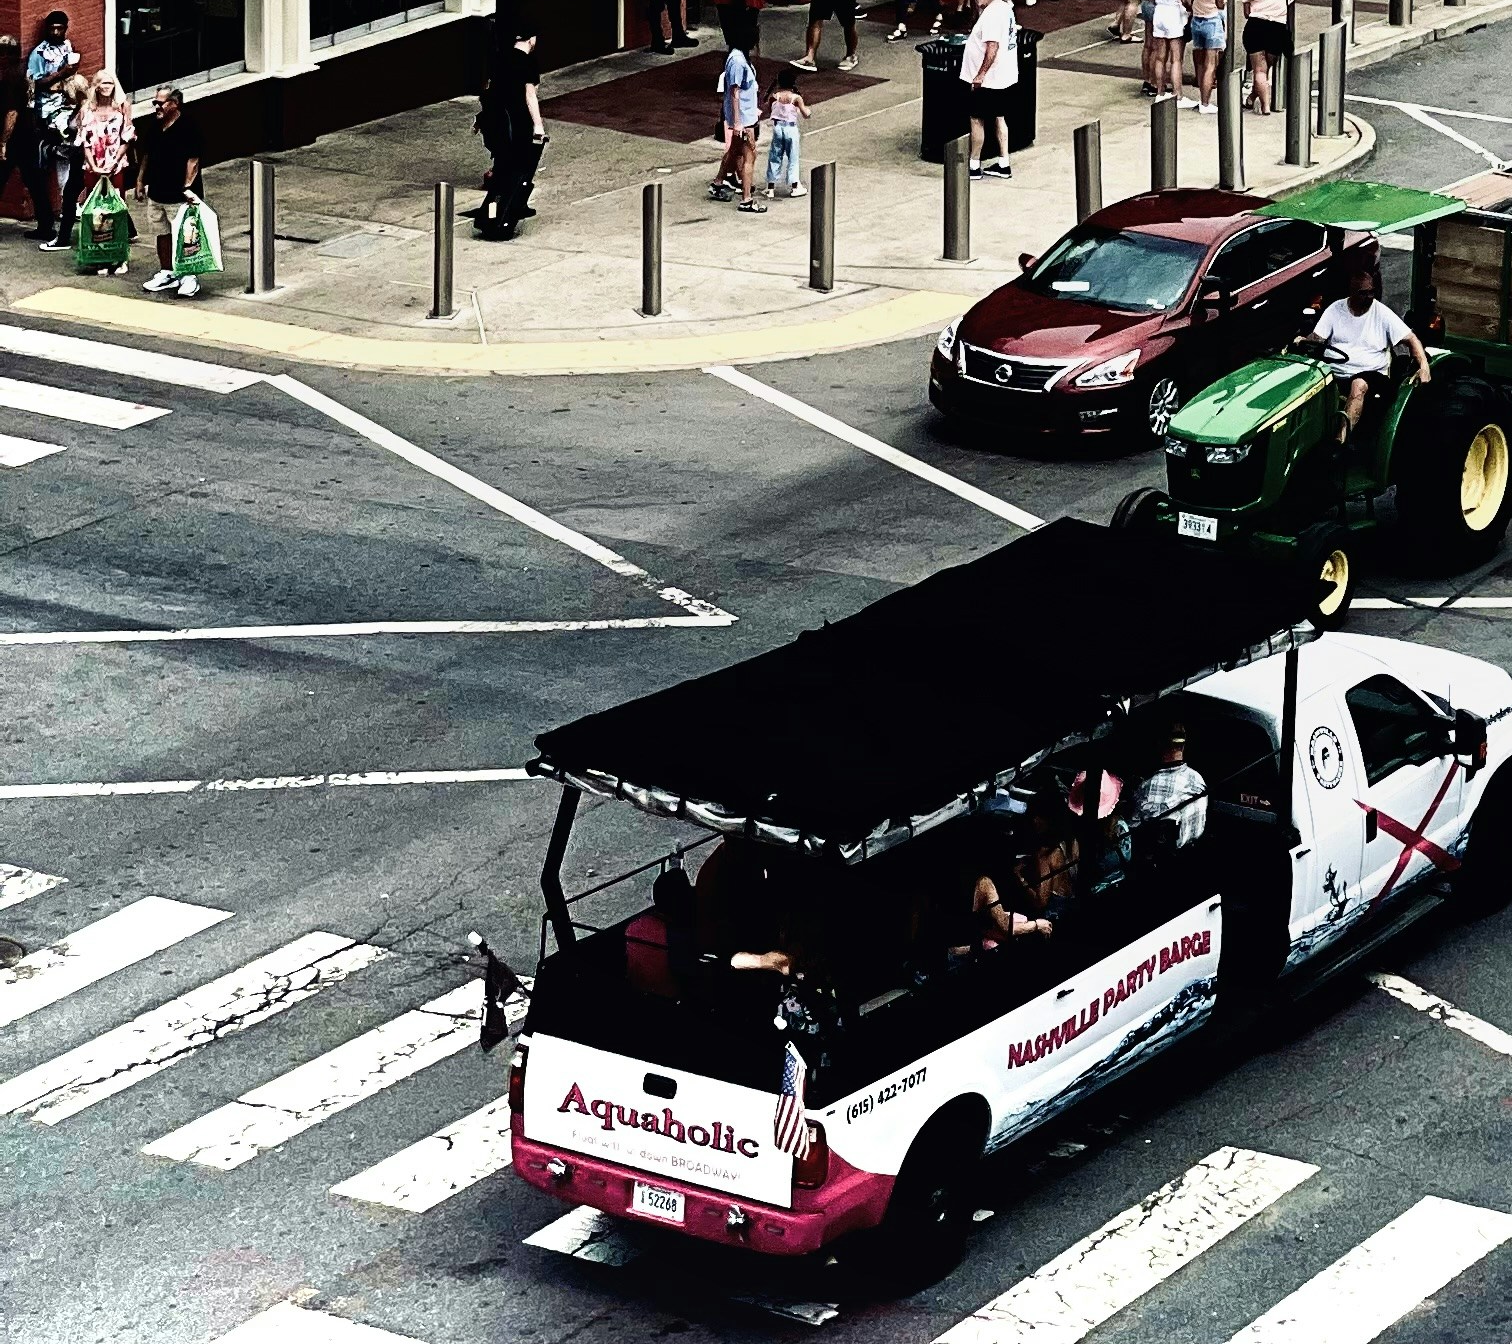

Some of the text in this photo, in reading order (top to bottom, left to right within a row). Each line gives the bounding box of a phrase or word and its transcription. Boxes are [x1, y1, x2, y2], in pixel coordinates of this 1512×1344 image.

[1007, 930, 1211, 1069] NASHVILLE PARTY BARGE
[557, 1081, 759, 1158] Aquaholic
[846, 1067, 927, 1124] (615) 422-7077
[648, 1192, 677, 1213] 52268
